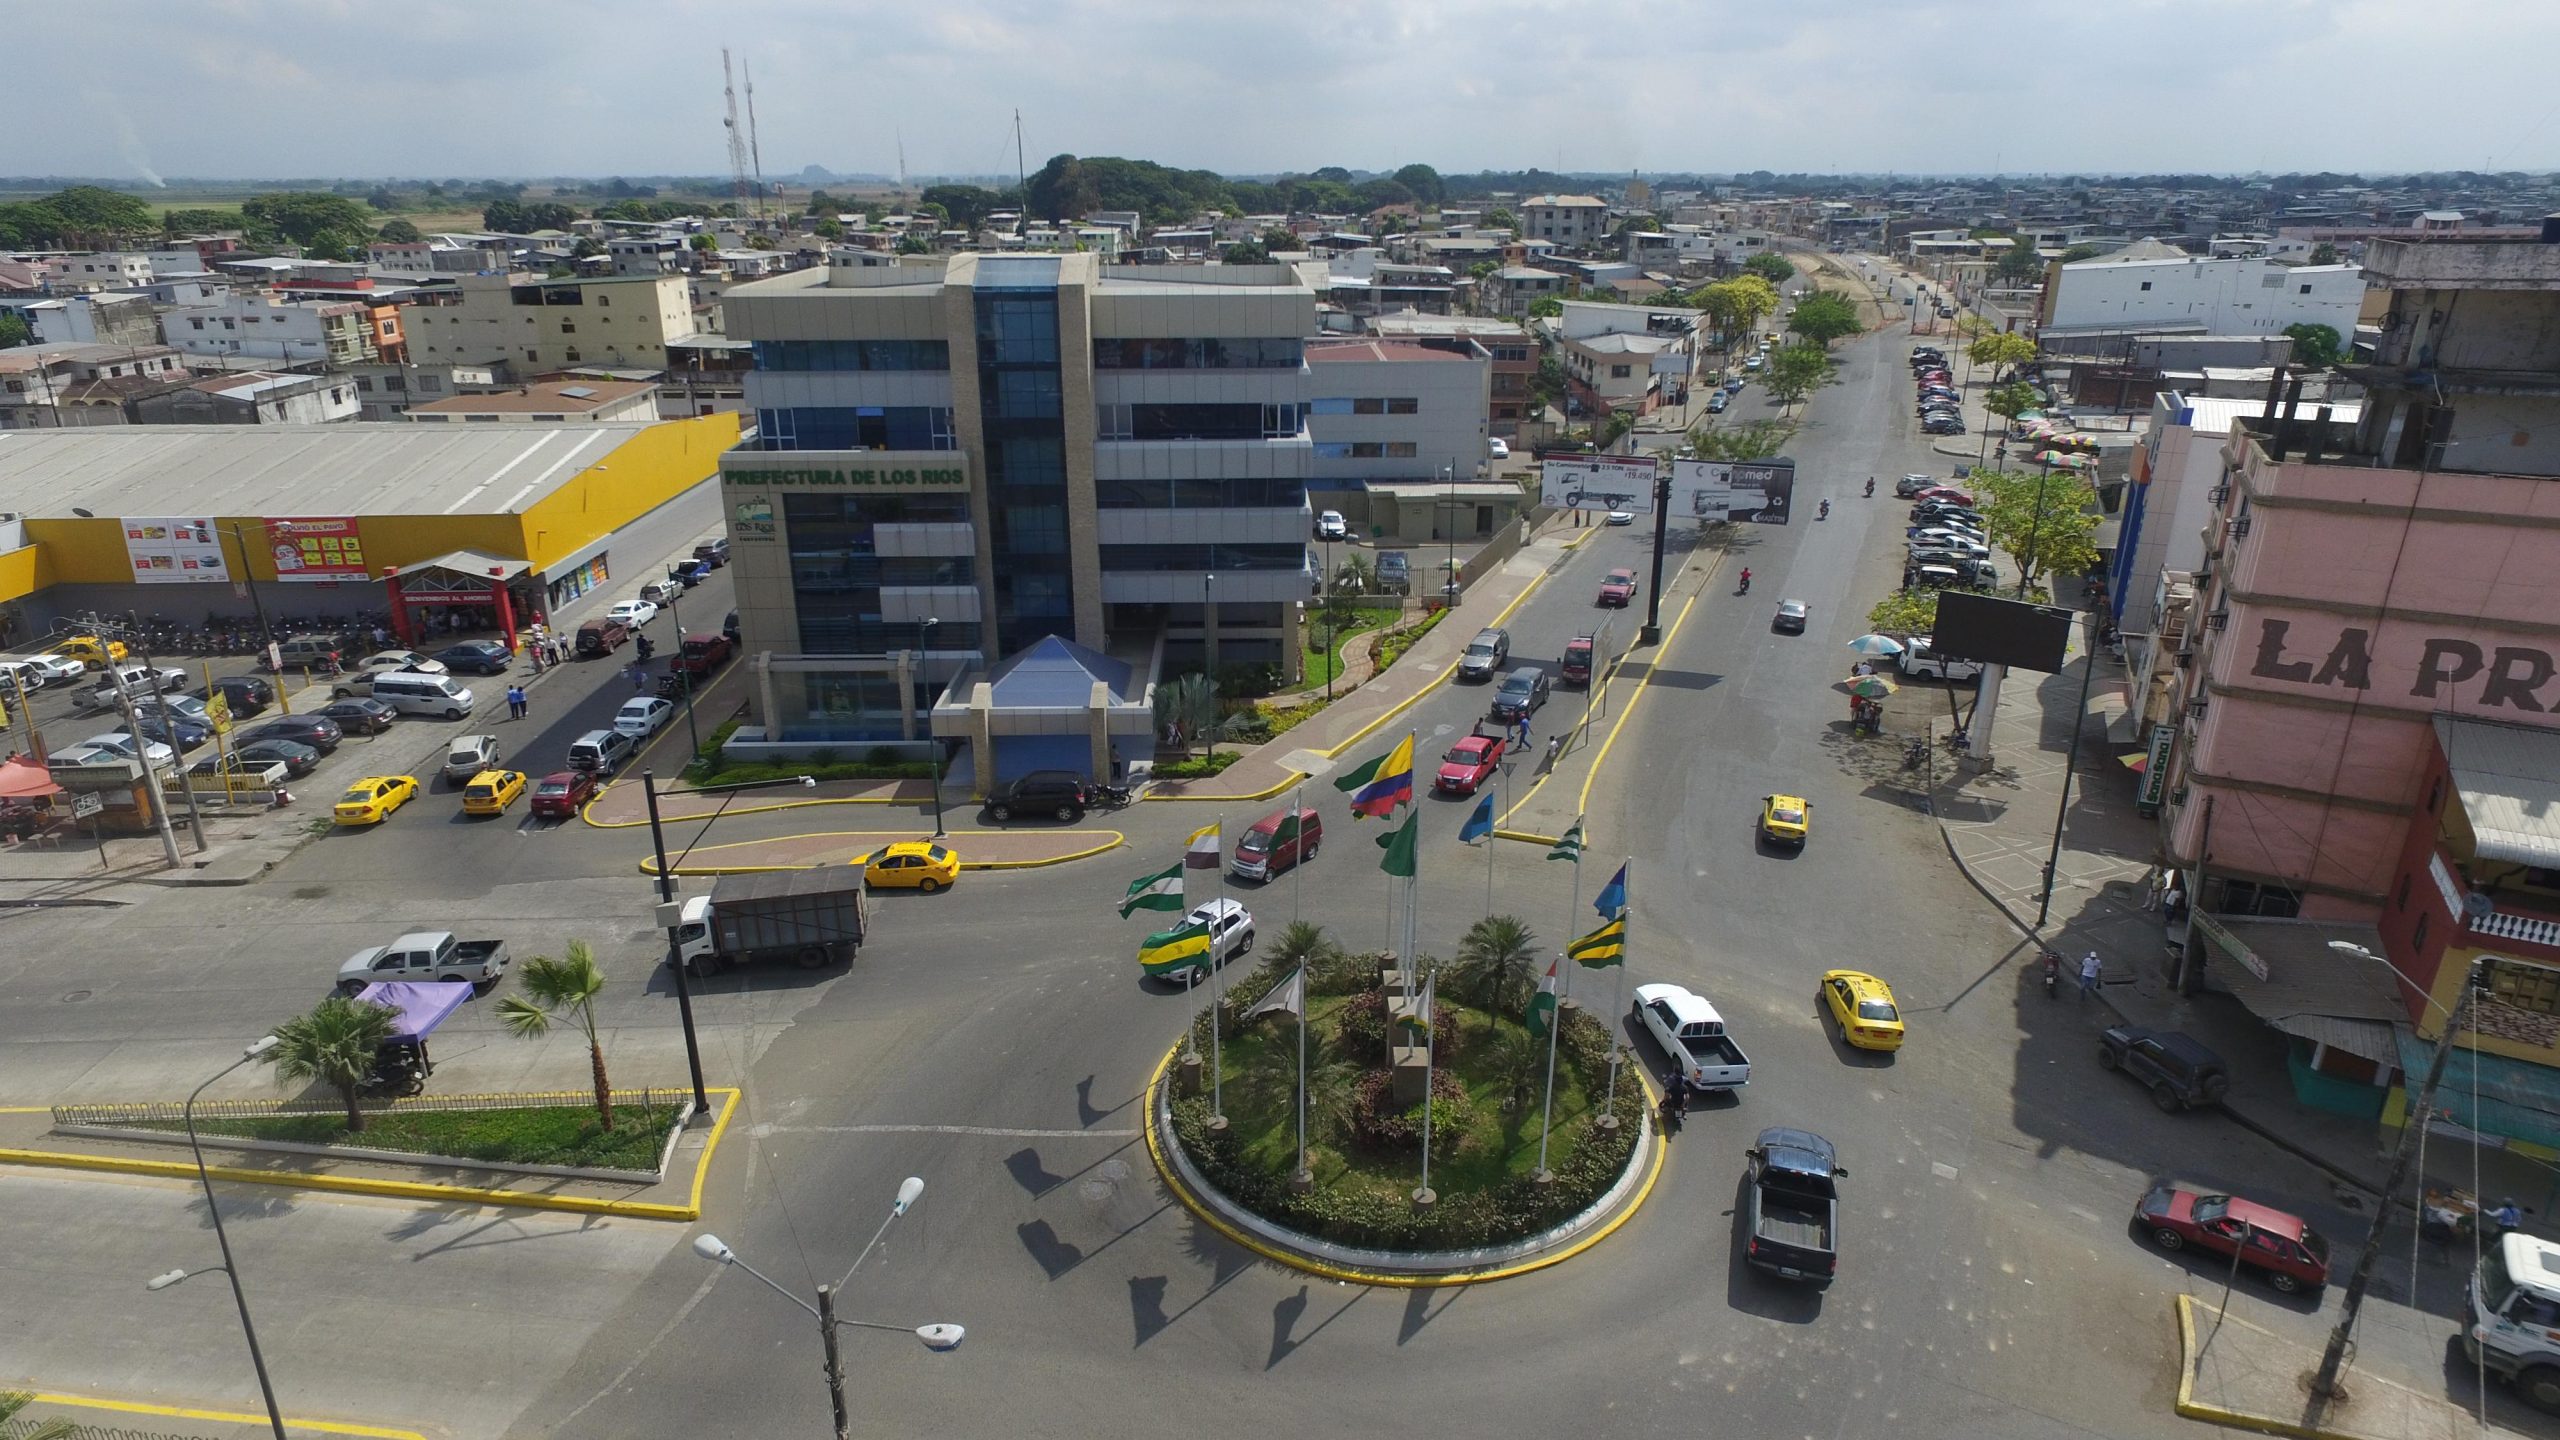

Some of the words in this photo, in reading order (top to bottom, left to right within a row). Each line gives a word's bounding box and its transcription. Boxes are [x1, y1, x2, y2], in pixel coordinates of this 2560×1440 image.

[724, 469, 846, 486] PREFECTURA
[851, 469, 876, 485] DE
[881, 469, 917, 485] LOS
[922, 469, 964, 484] RIOS
[2250, 618, 2373, 690] LA
[2409, 638, 2560, 714] PR
